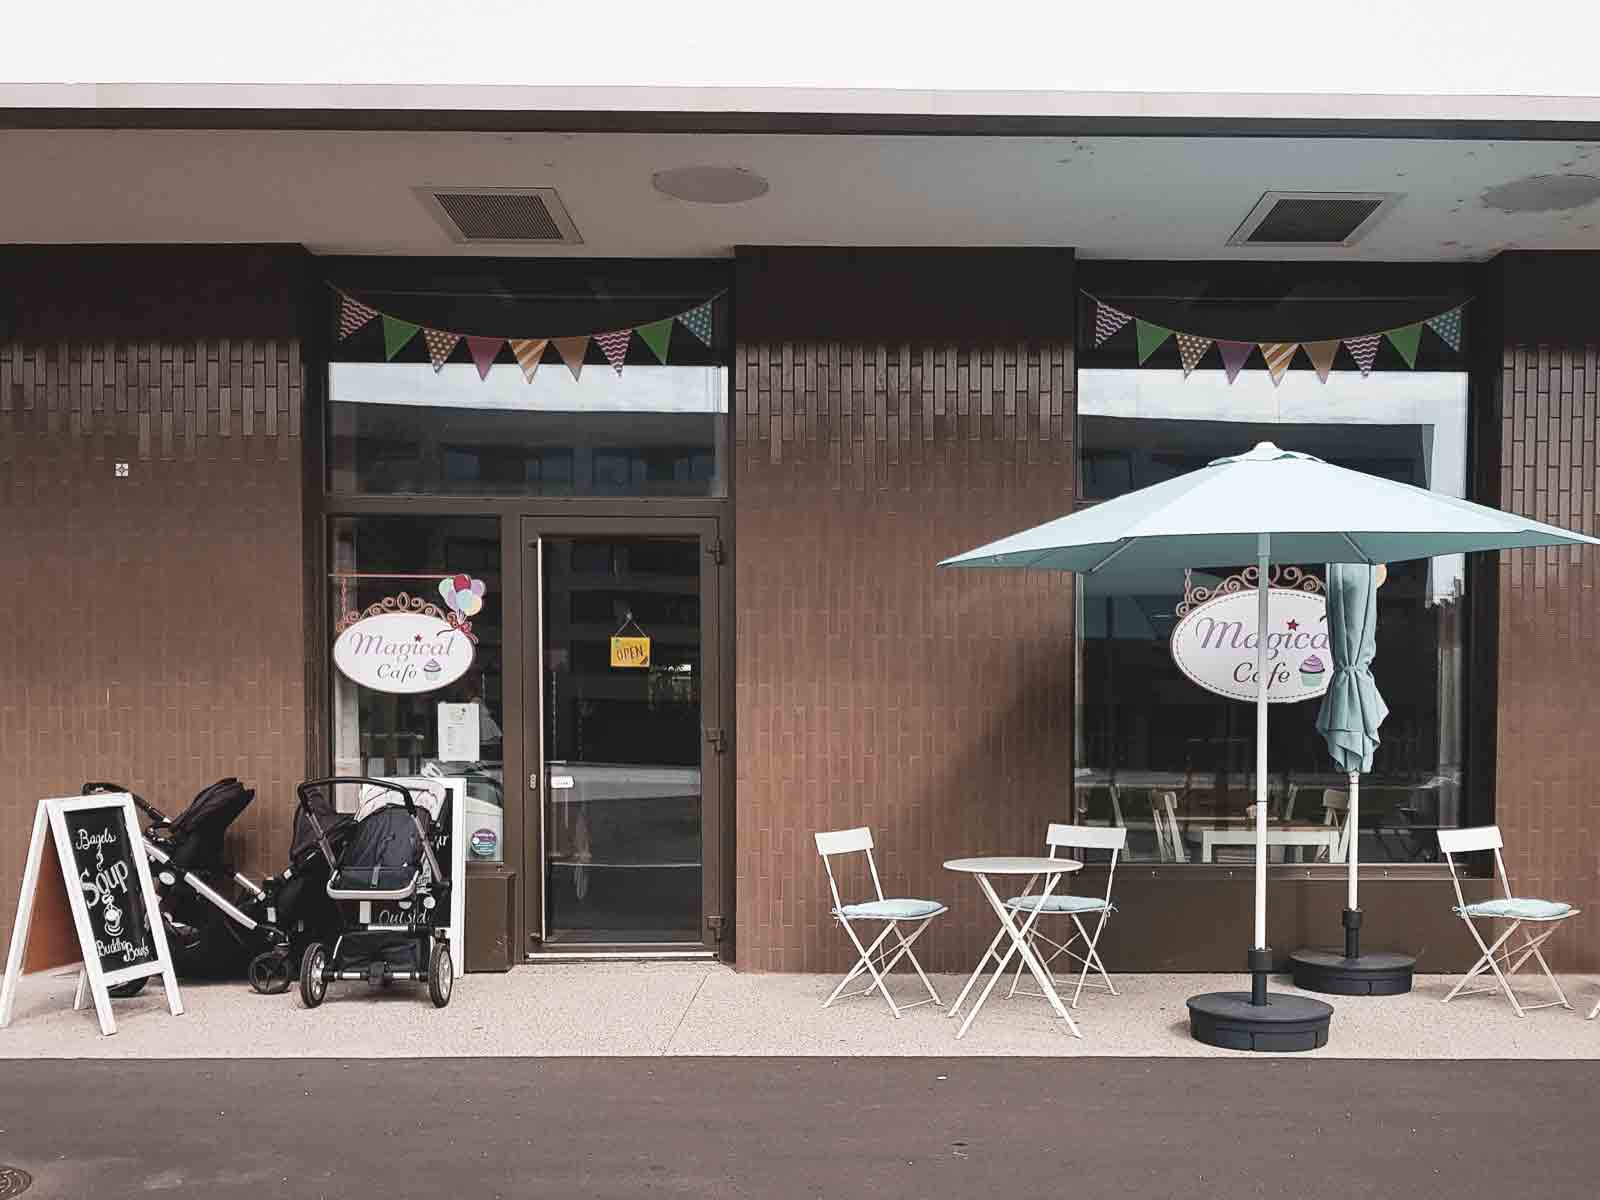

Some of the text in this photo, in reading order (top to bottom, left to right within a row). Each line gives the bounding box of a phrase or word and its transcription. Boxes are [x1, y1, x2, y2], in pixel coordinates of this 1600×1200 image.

[351, 632, 454, 662] Magical
[1196, 617, 1329, 660] Magica
[616, 645, 644, 661] OPEN
[76, 827, 117, 850] Bagels
[80, 861, 128, 909] Soup
[379, 908, 431, 924] Outsid
